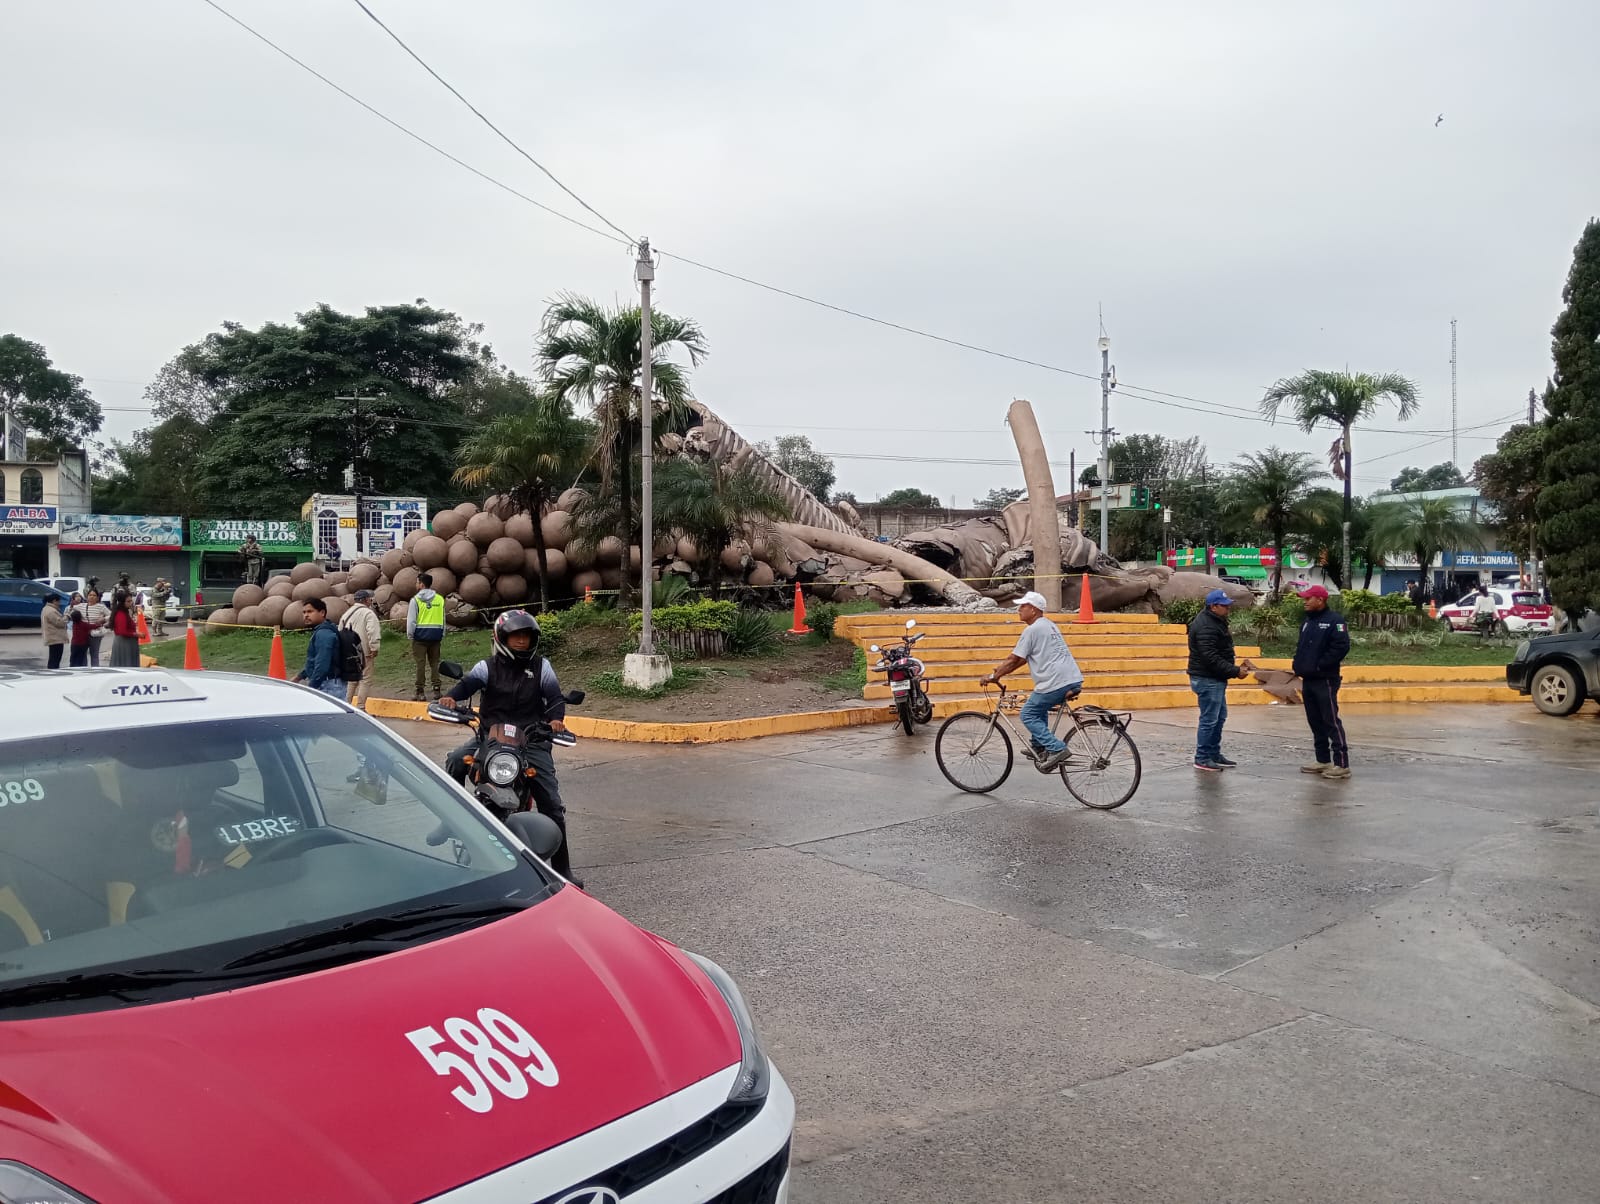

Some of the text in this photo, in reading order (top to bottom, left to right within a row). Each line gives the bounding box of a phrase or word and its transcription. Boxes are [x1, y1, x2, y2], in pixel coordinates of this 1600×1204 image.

[7, 508, 49, 519] ALBA
[216, 520, 289, 532] MILES DE
[208, 530, 296, 541] TORNILLOS
[117, 684, 160, 697] TAXI
[220, 816, 296, 844] LIBRE
[404, 1007, 560, 1114] 589
